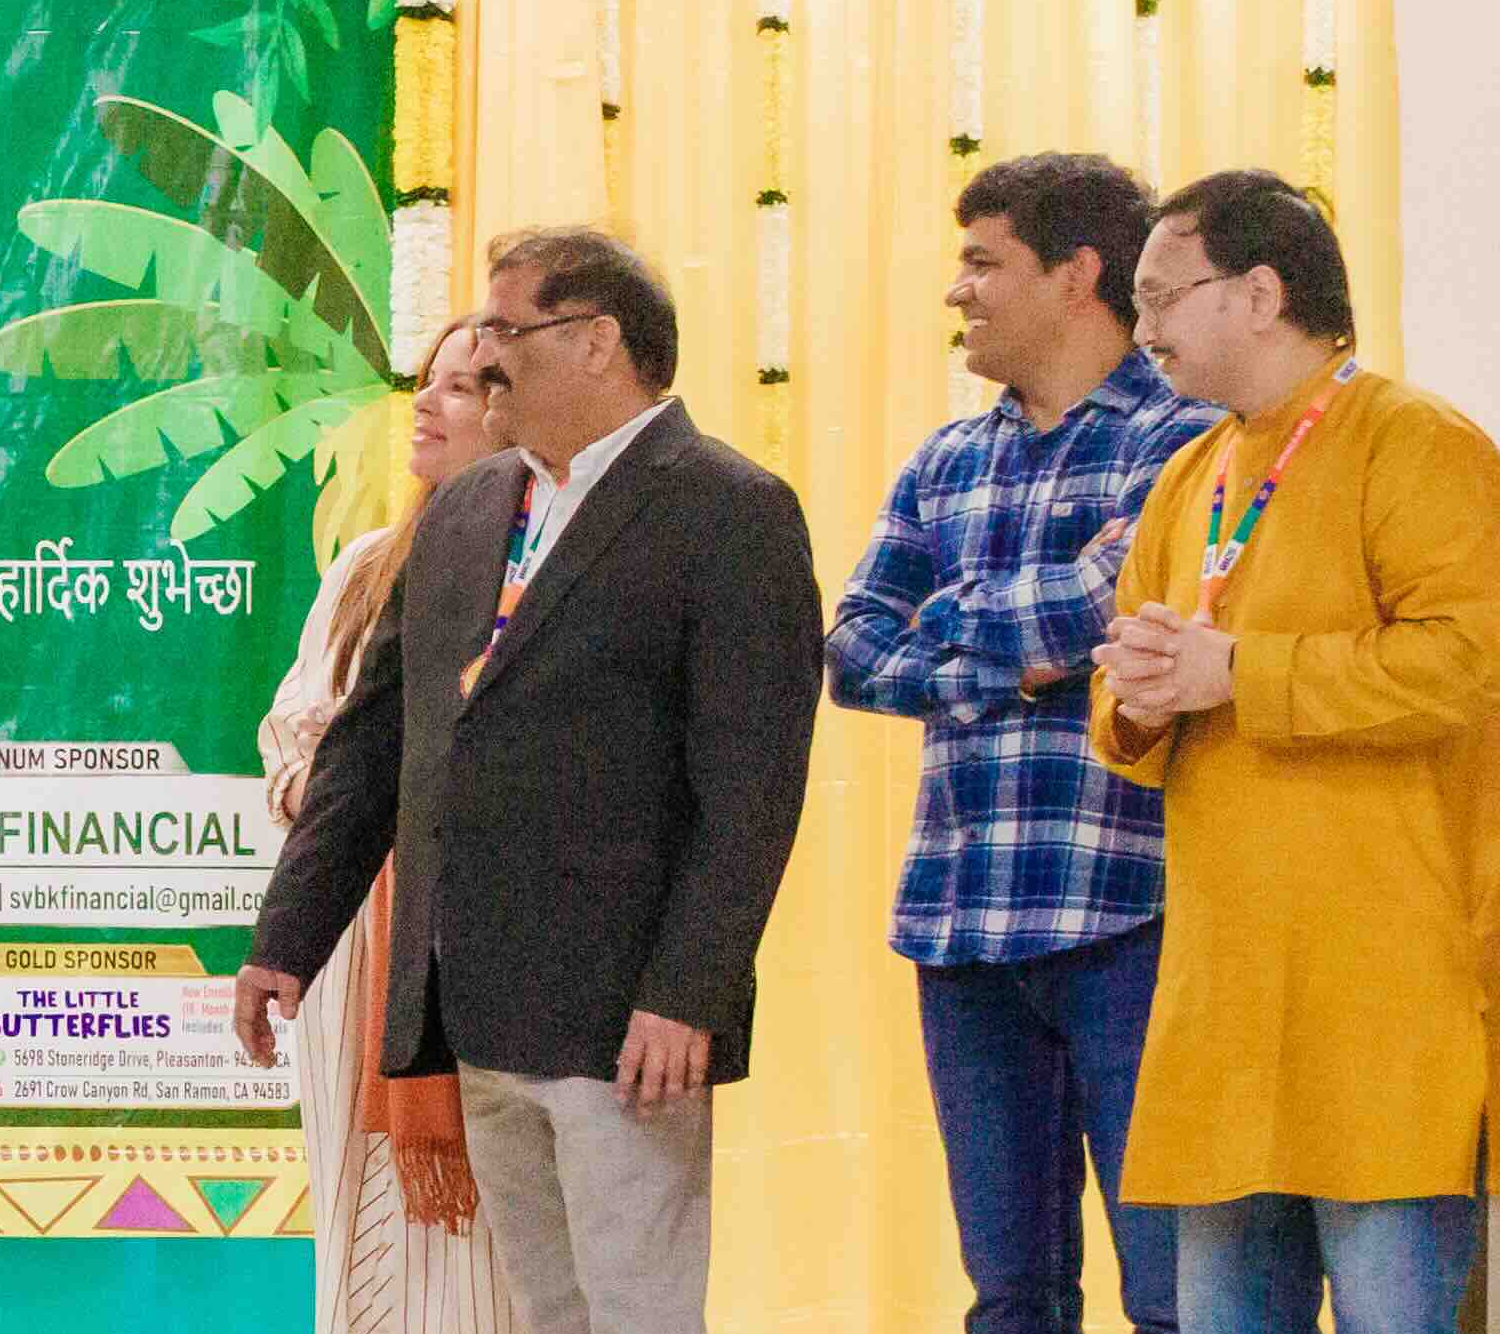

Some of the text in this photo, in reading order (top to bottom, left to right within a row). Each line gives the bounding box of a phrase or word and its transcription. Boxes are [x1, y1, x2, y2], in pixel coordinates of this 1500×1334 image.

[54, 748, 160, 770] SPONSOR
[10, 884, 266, 917] svbkfinancial@gmail.co
[5, 950, 157, 970] GOLD SPONSOR
[17, 989, 140, 1010] THE LITTLE
[48, 1049, 115, 1071] Stoneridge
[119, 1049, 152, 1070] Drive,
[14, 1081, 44, 1099] 2691
[46, 1081, 78, 1099] Crow
[83, 1081, 129, 1103] Canyon
[156, 1082, 180, 1099] San
[184, 1082, 231, 1103] Ramon,
[234, 1082, 249, 1100] CA
[253, 1082, 291, 1100] 94583
